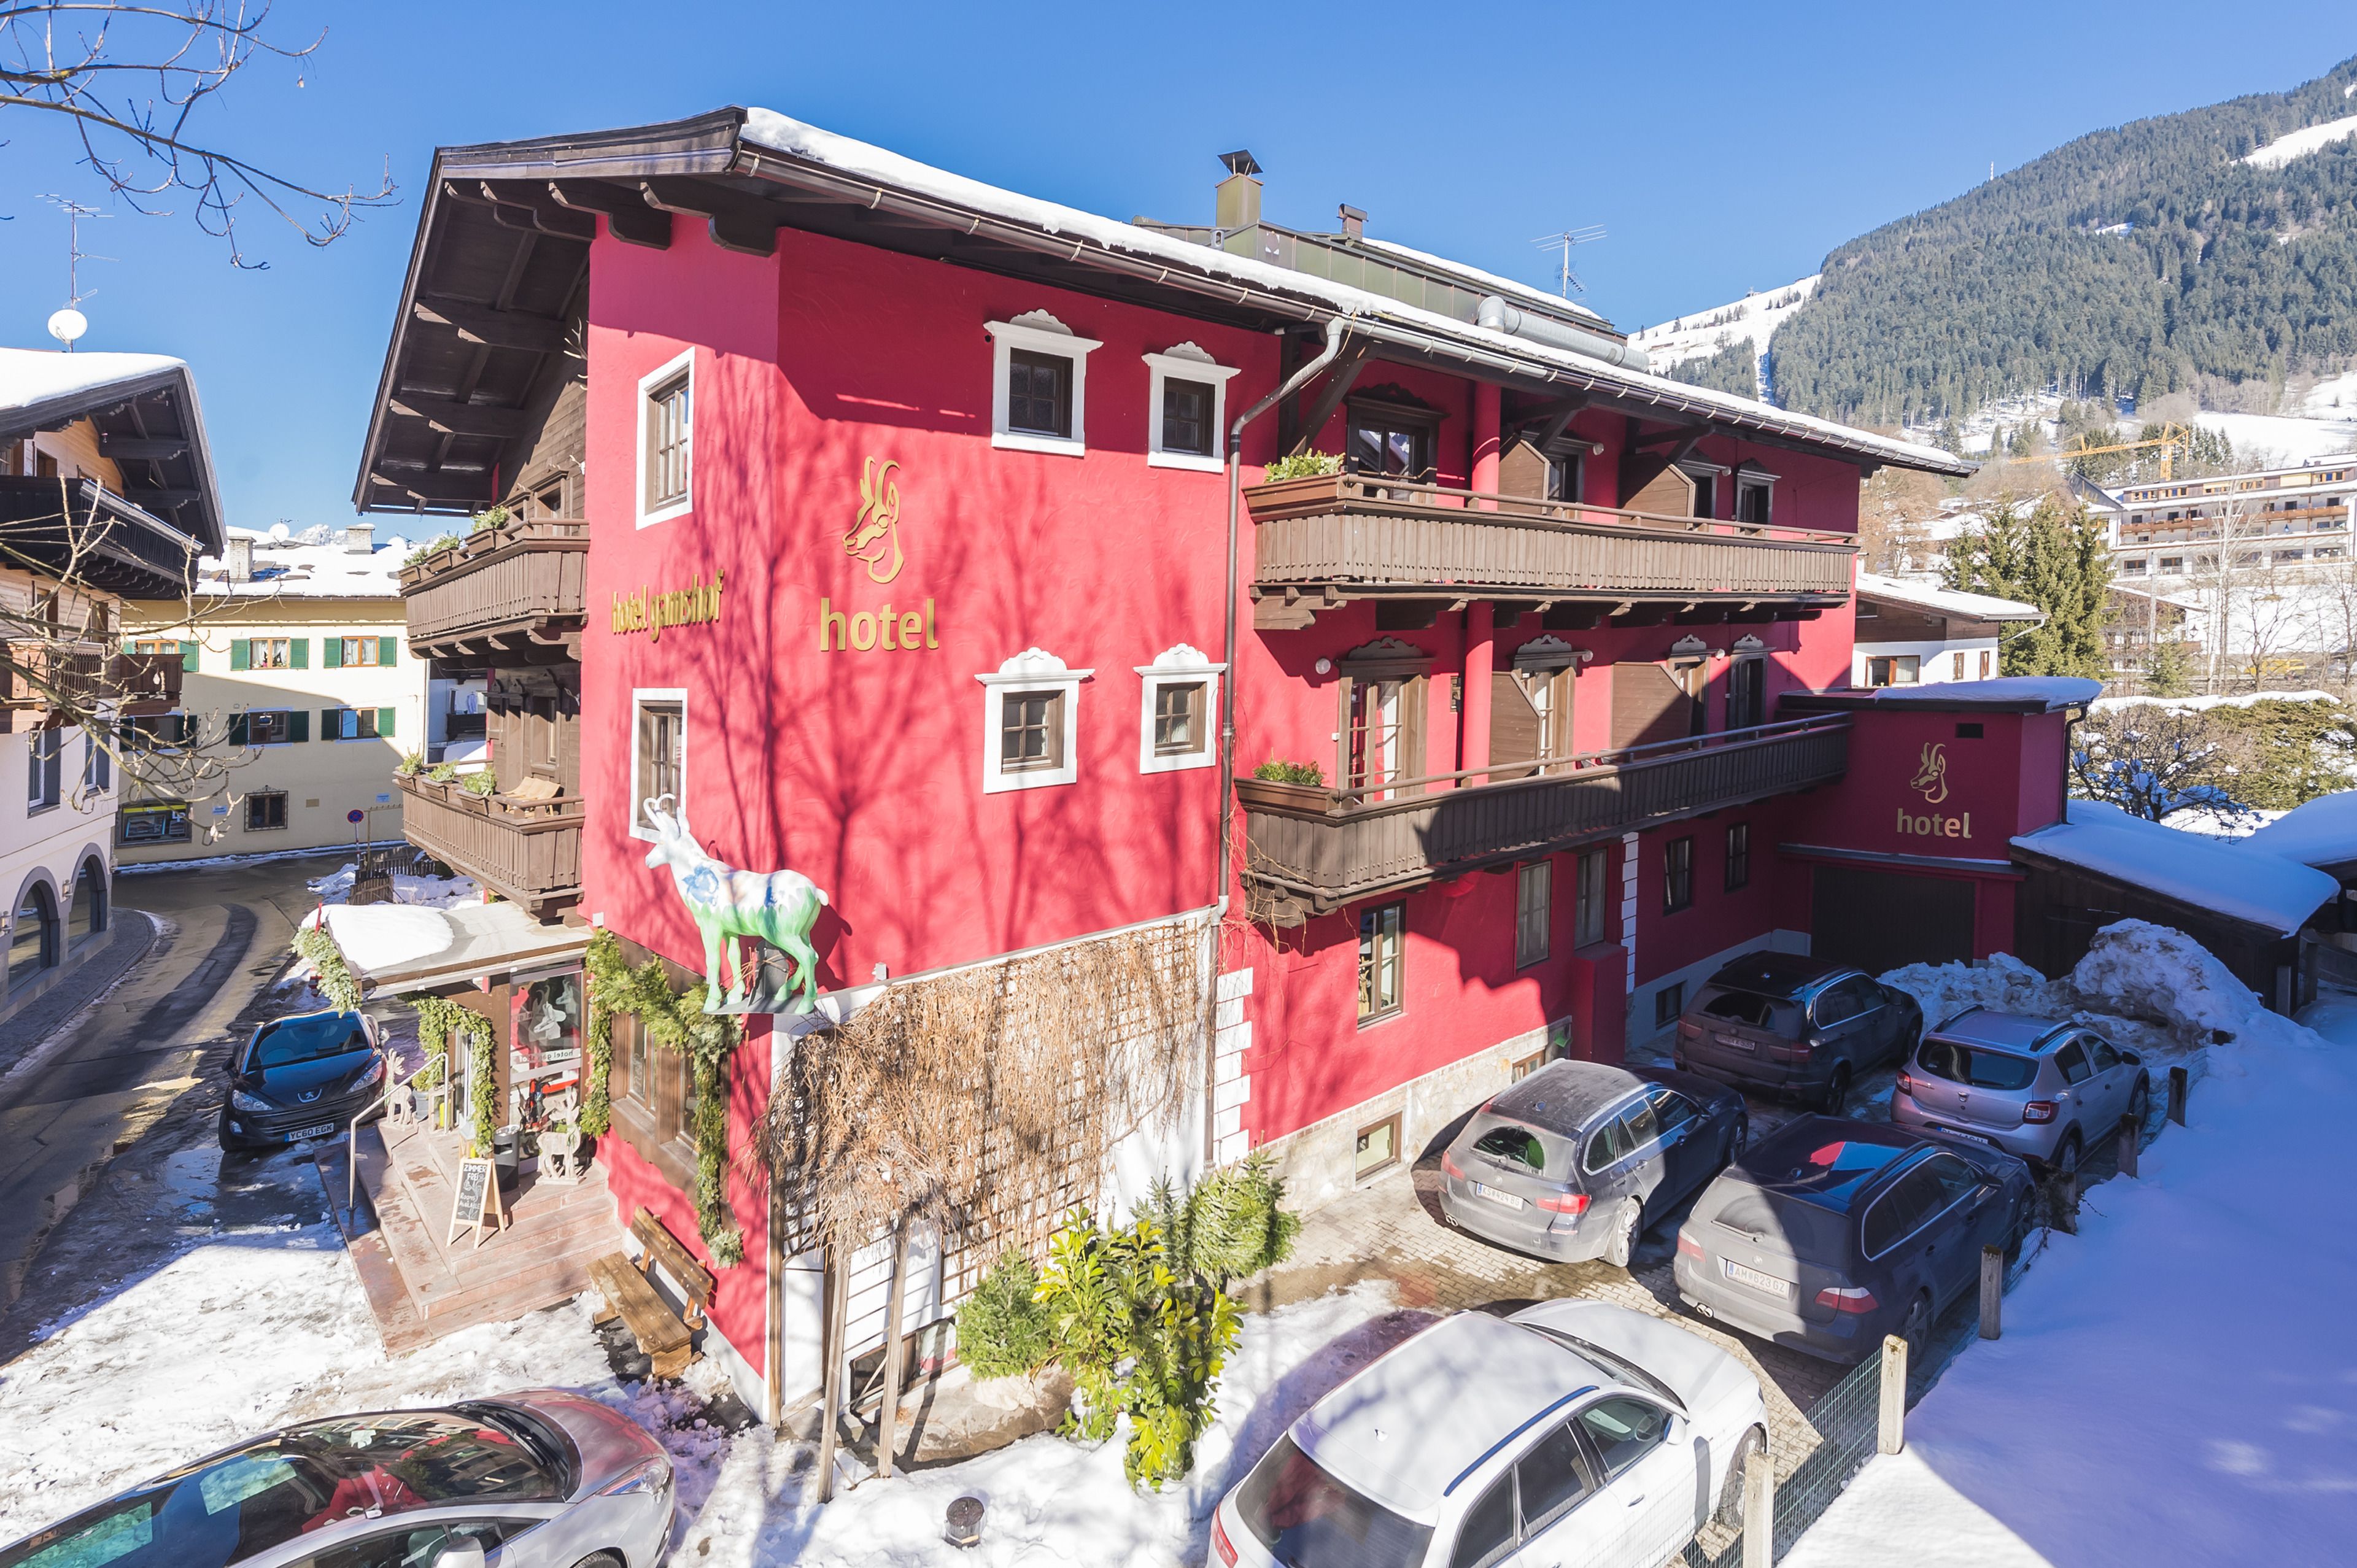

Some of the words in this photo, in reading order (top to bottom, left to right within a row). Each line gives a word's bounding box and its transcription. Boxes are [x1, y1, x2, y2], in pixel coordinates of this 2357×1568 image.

[613, 585, 648, 633] hotel
[650, 569, 725, 642] gamshof
[820, 597, 939, 651] hotel
[1897, 808, 1972, 839] hotel
[290, 1129, 313, 1139] YC60
[315, 1124, 333, 1134] EGK
[1482, 1186, 1492, 1196] KS
[1496, 1191, 1509, 1202] 424
[1510, 1197, 1520, 1206] BG
[1754, 1274, 1771, 1288] 623
[1773, 1281, 1785, 1292] GZ
